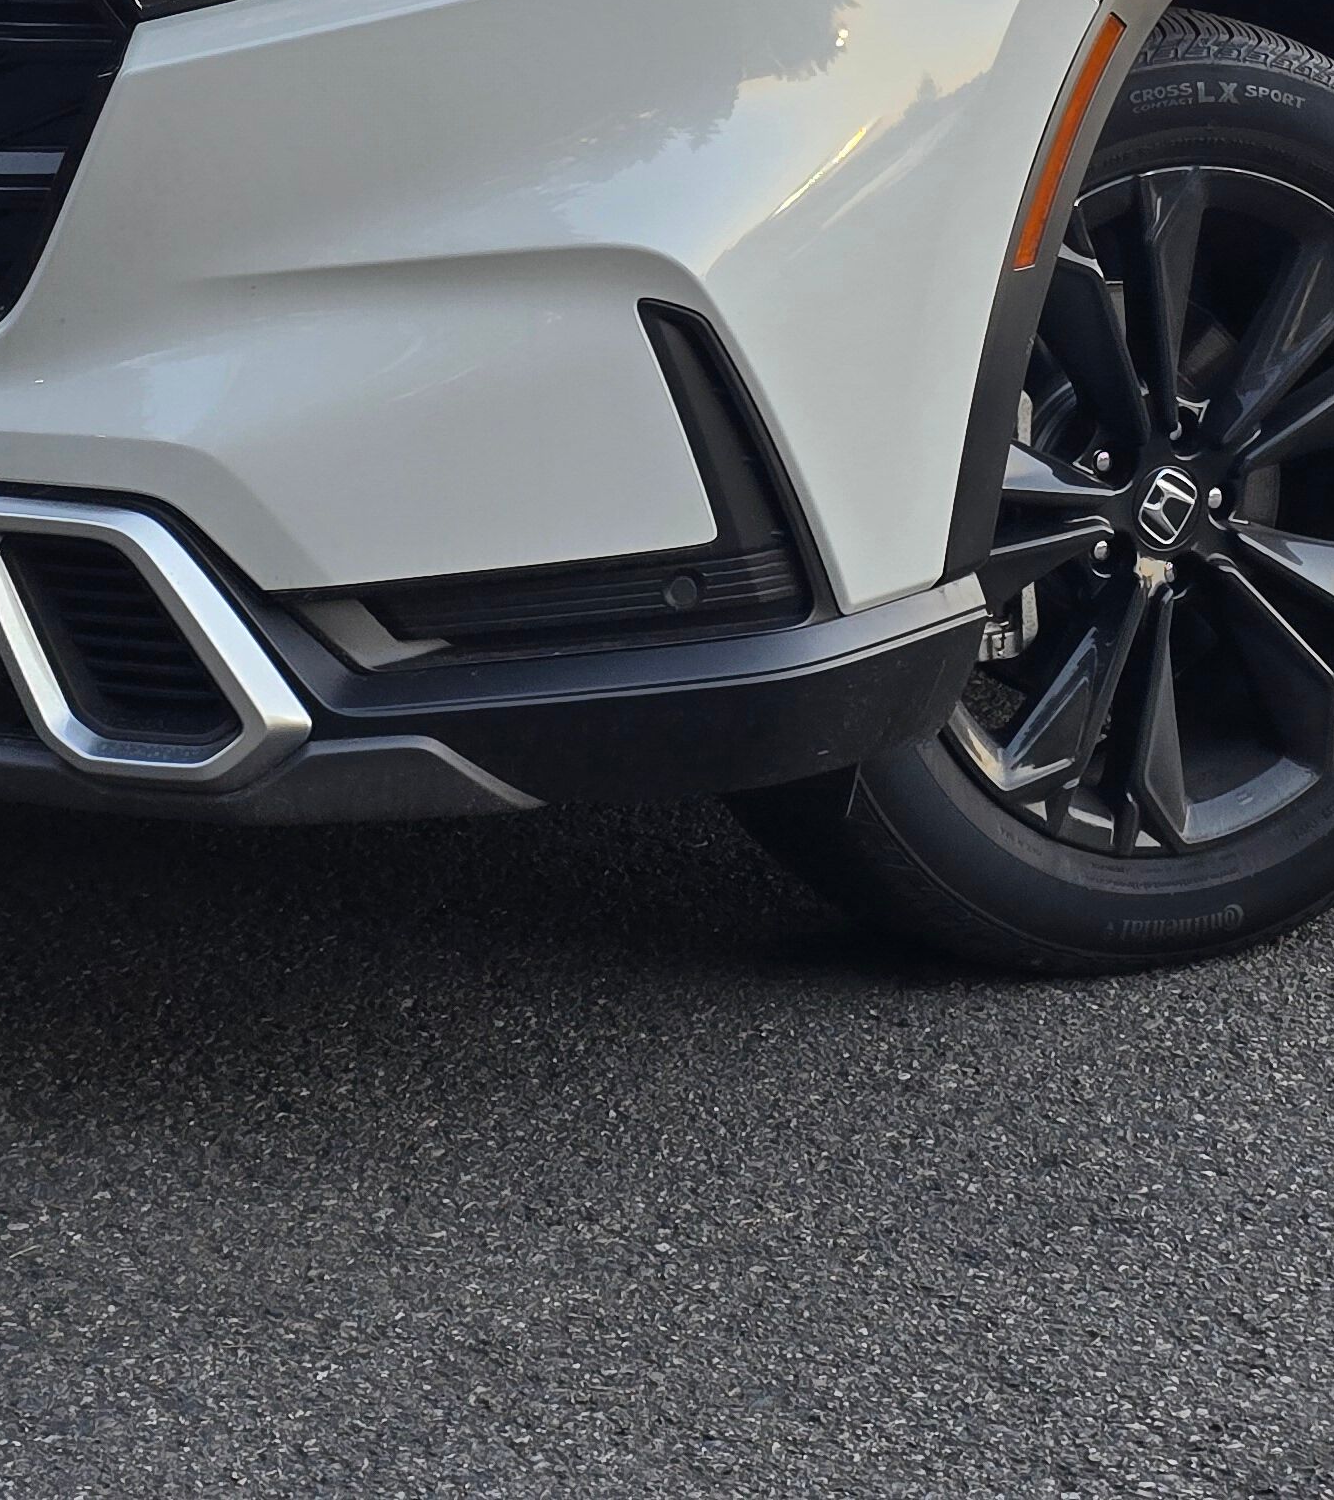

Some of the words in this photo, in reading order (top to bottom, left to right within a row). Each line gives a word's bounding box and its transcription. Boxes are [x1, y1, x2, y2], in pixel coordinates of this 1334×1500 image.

[1129, 82, 1193, 104] CROSS
[1196, 81, 1240, 105] LX
[1244, 84, 1307, 109] SPORT
[1132, 97, 1194, 114] CONTACT
